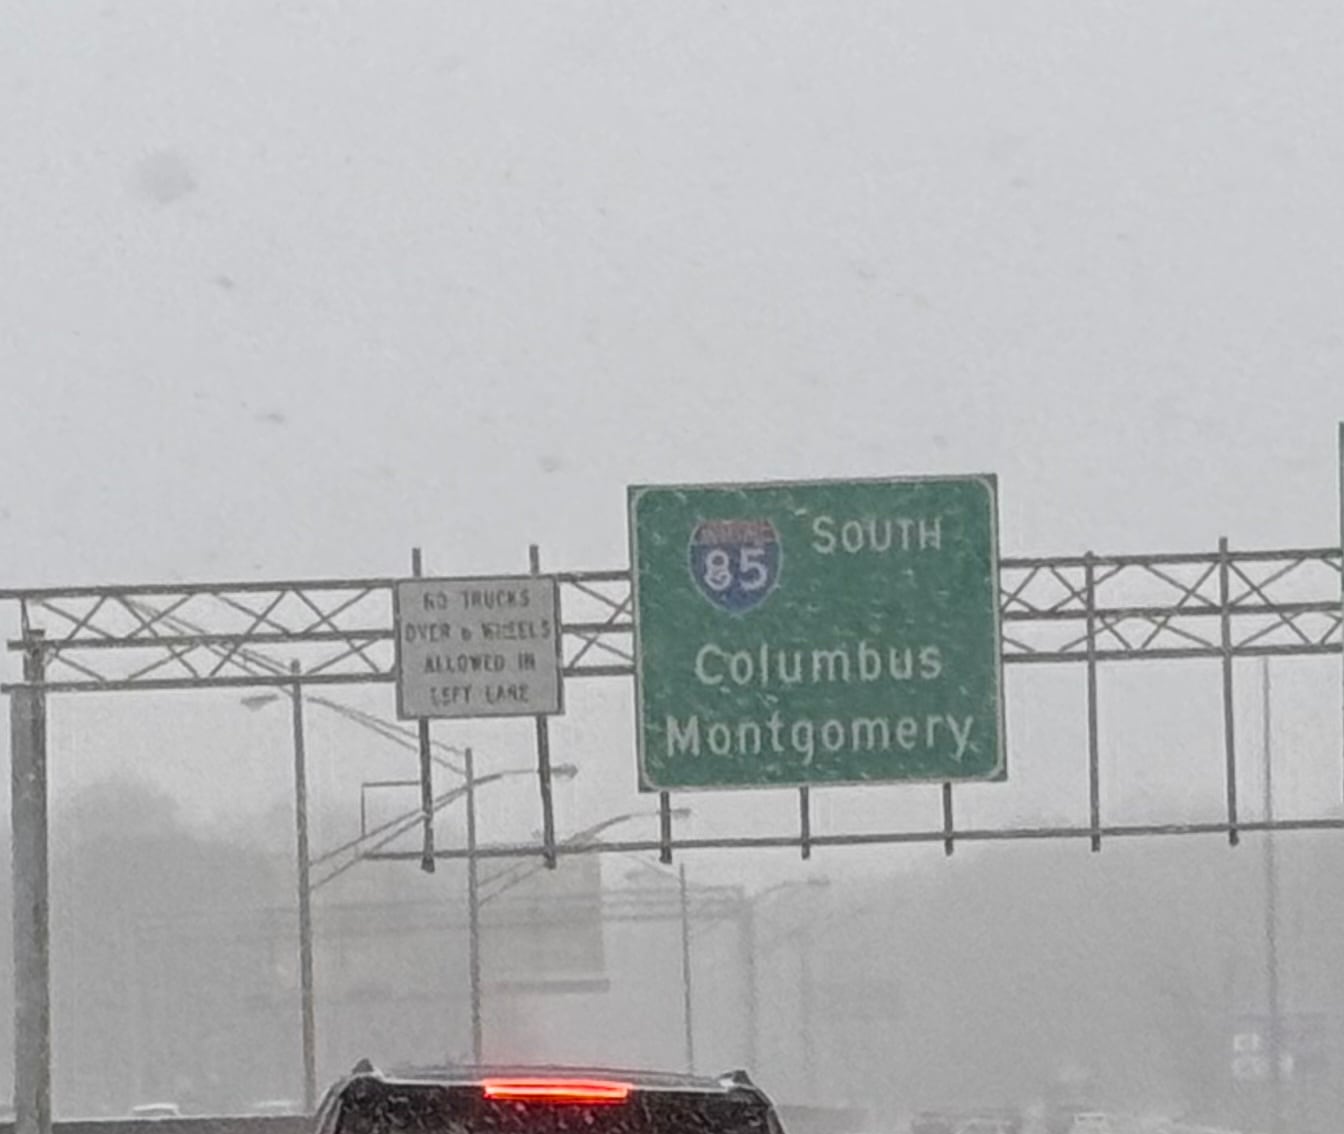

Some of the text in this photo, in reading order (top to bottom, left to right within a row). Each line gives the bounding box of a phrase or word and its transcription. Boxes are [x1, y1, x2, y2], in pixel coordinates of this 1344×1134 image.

[811, 515, 943, 555] SOUTH
[703, 547, 769, 591] 85
[462, 588, 531, 610] TRUCKS
[405, 622, 451, 643] OVER
[481, 619, 552, 641] WHEELS
[423, 651, 536, 674] ALLOWED IN
[694, 641, 944, 687] Columbus
[429, 683, 529, 706] LEFT LANE
[664, 710, 974, 765] Montgomery
